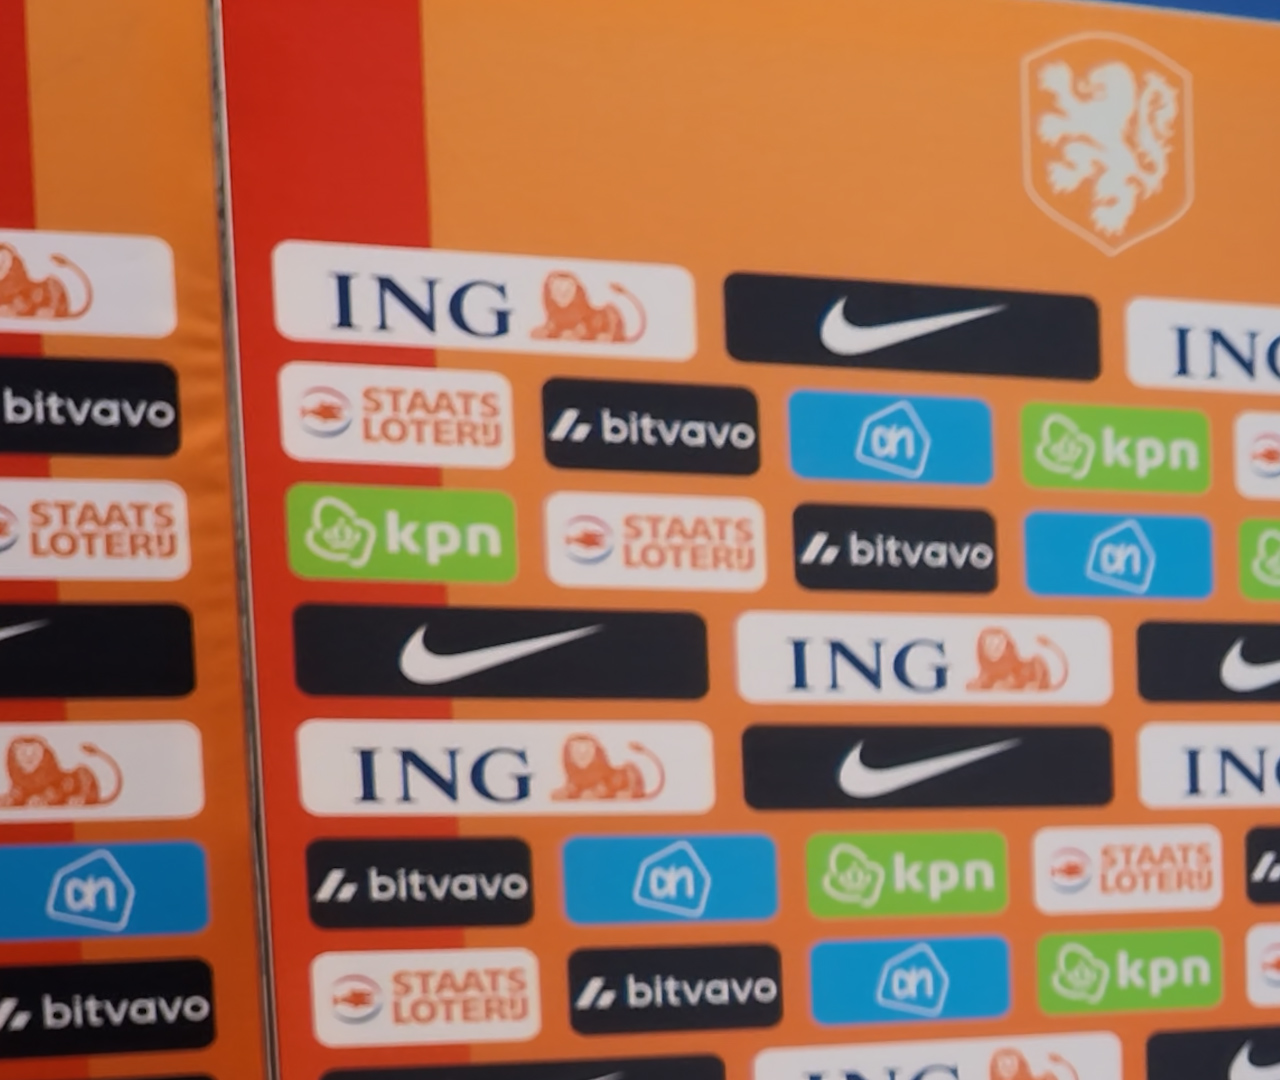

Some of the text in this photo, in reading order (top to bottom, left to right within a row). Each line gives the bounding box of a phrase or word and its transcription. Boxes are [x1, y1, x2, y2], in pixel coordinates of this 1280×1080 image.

[330, 271, 514, 338] ING
[4, 388, 174, 427] bitvavo
[363, 386, 499, 418] STAATS
[602, 409, 755, 448] bitvavo
[1102, 426, 1199, 477] kpn
[30, 499, 174, 529] STAATS
[624, 515, 753, 543] STAATS
[386, 510, 501, 565] kpn
[850, 532, 993, 568] bitvavo
[788, 637, 951, 693] ING
[354, 747, 533, 803] ING
[1101, 843, 1211, 866] STAATS
[369, 867, 528, 900] bitvavo
[893, 853, 994, 901] kpn
[392, 968, 526, 994] STAATS
[627, 975, 777, 1007] bitvavo
[1117, 950, 1210, 996] kpn
[43, 995, 209, 1028] bitvavo
